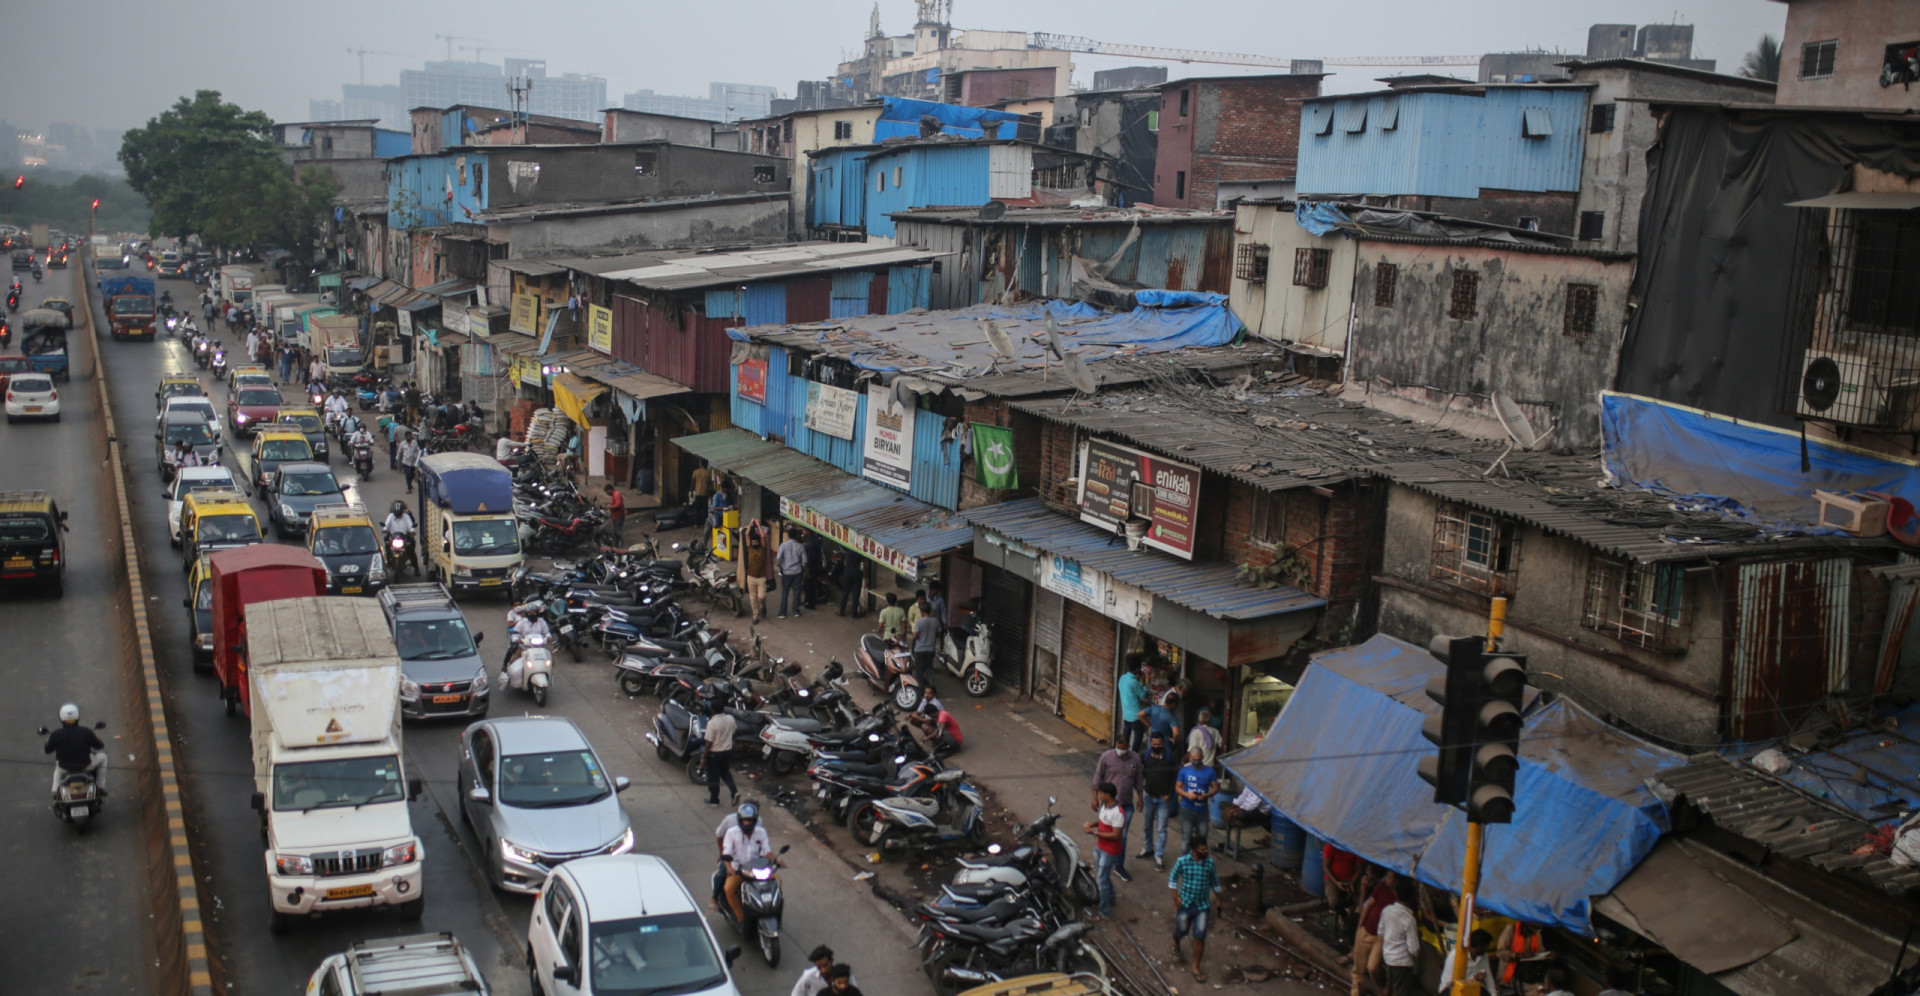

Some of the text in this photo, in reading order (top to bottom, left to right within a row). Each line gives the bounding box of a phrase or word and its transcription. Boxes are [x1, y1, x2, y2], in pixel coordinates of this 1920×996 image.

[879, 429, 898, 441] MUMBAI
[874, 437, 901, 456] BIRYANI
[1156, 469, 1190, 495] enikah
